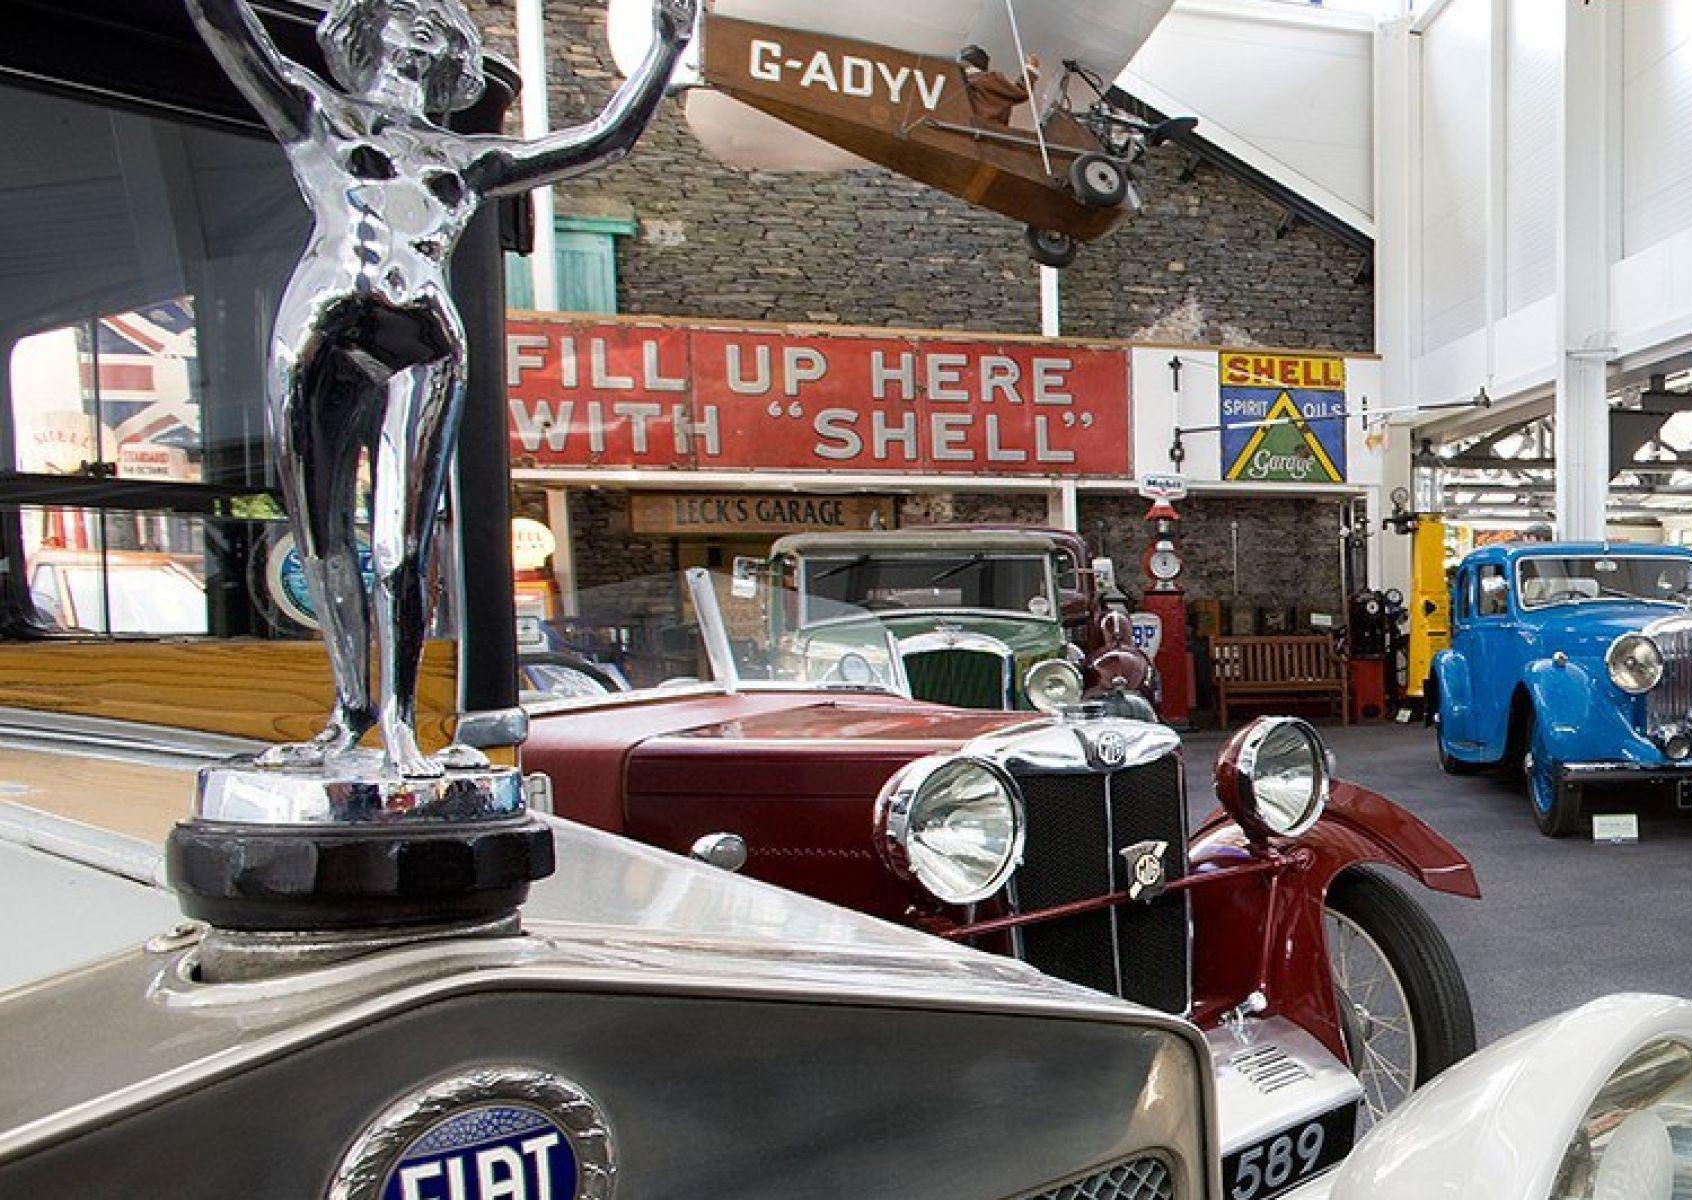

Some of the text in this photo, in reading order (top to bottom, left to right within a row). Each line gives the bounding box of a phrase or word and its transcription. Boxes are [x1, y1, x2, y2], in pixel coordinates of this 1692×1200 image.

[748, 39, 947, 111] G-ADYV
[506, 334, 1075, 406] FILL UP HERE
[1226, 356, 1341, 386] SHELL
[509, 397, 722, 456] WITH
[1223, 398, 1345, 419] SPIRIT OILS
[1247, 448, 1317, 479] Garage
[755, 499, 846, 527] GARAGE
[399, 1132, 559, 1200] FIAT
[1231, 1122, 1325, 1200] 589
